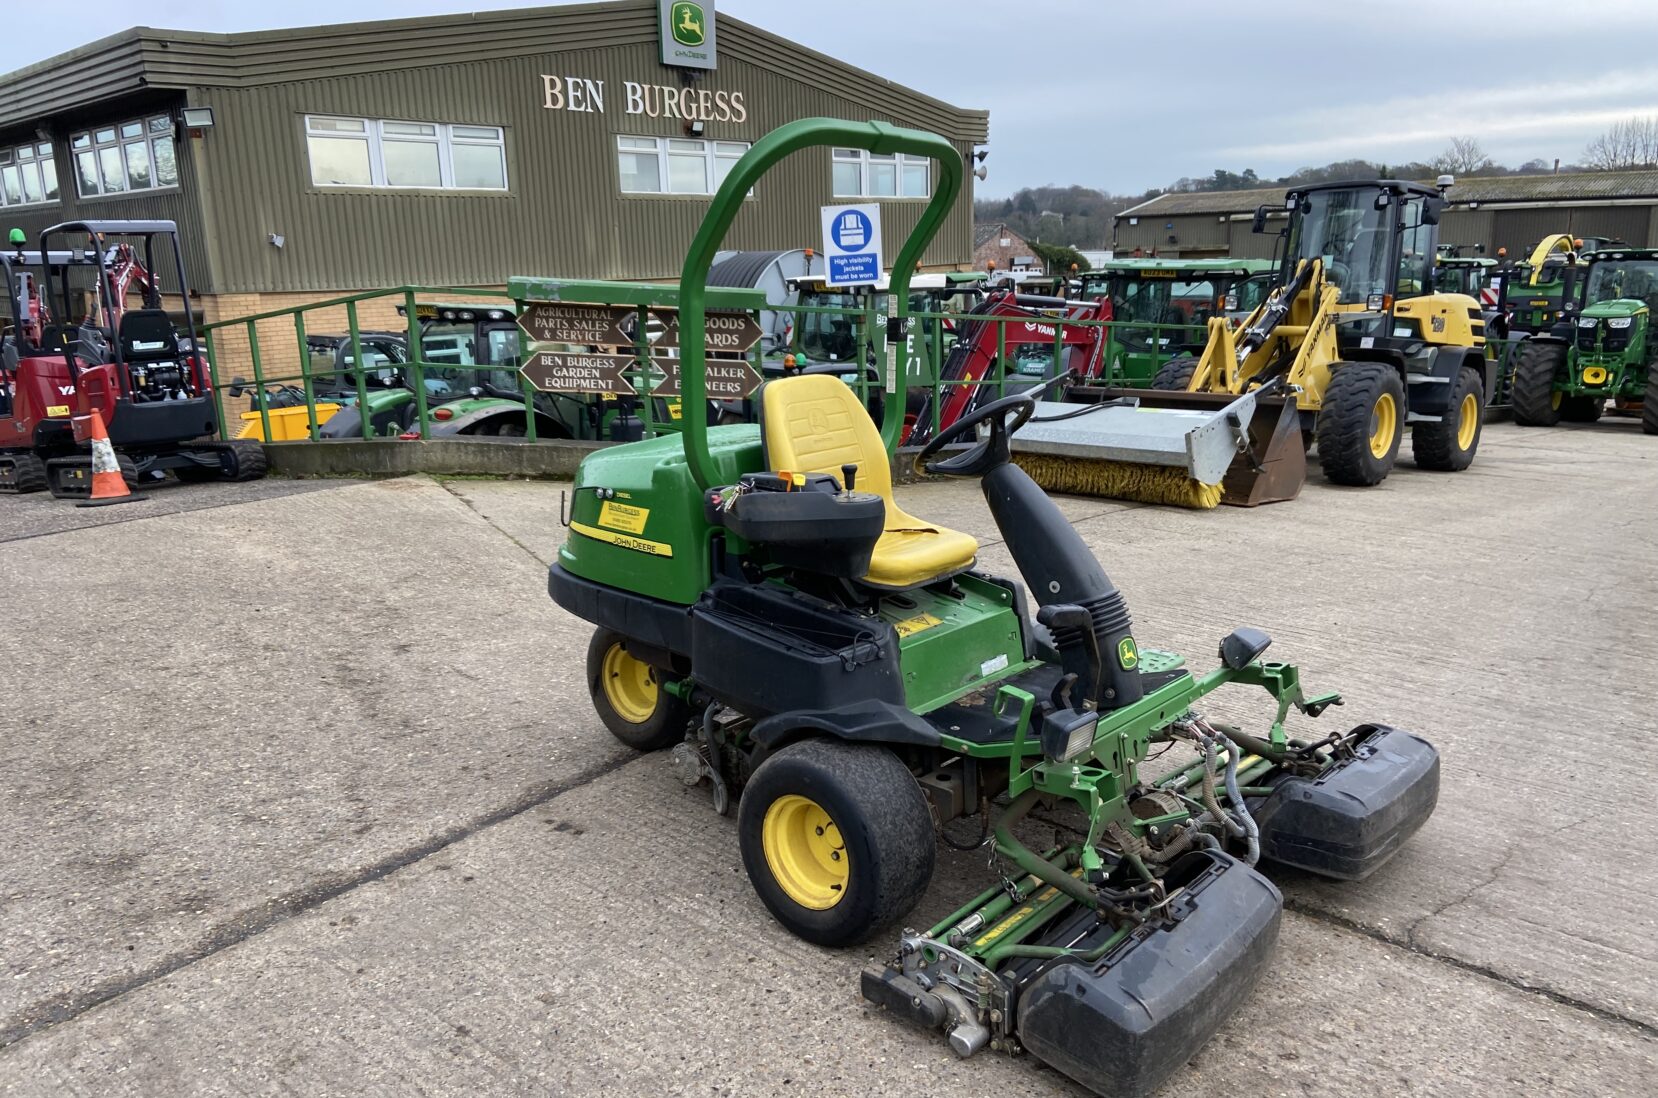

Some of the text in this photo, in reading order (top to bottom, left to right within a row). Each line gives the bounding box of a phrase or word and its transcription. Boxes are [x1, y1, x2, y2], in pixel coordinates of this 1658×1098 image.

[541, 74, 748, 123] BEN BURGESS
[834, 256, 873, 266] High visibility
[843, 265, 864, 273] jackets
[535, 307, 614, 320] AGRICULTURAL
[573, 320, 609, 331] SALES
[543, 330, 604, 341] & SERVICE
[541, 355, 616, 369] BEN BURGESS
[552, 367, 601, 378] GARDEN
[545, 378, 614, 390] EQUIPMENT
[674, 379, 741, 392] ENEERS
[613, 536, 656, 553] JOHN DEERE
